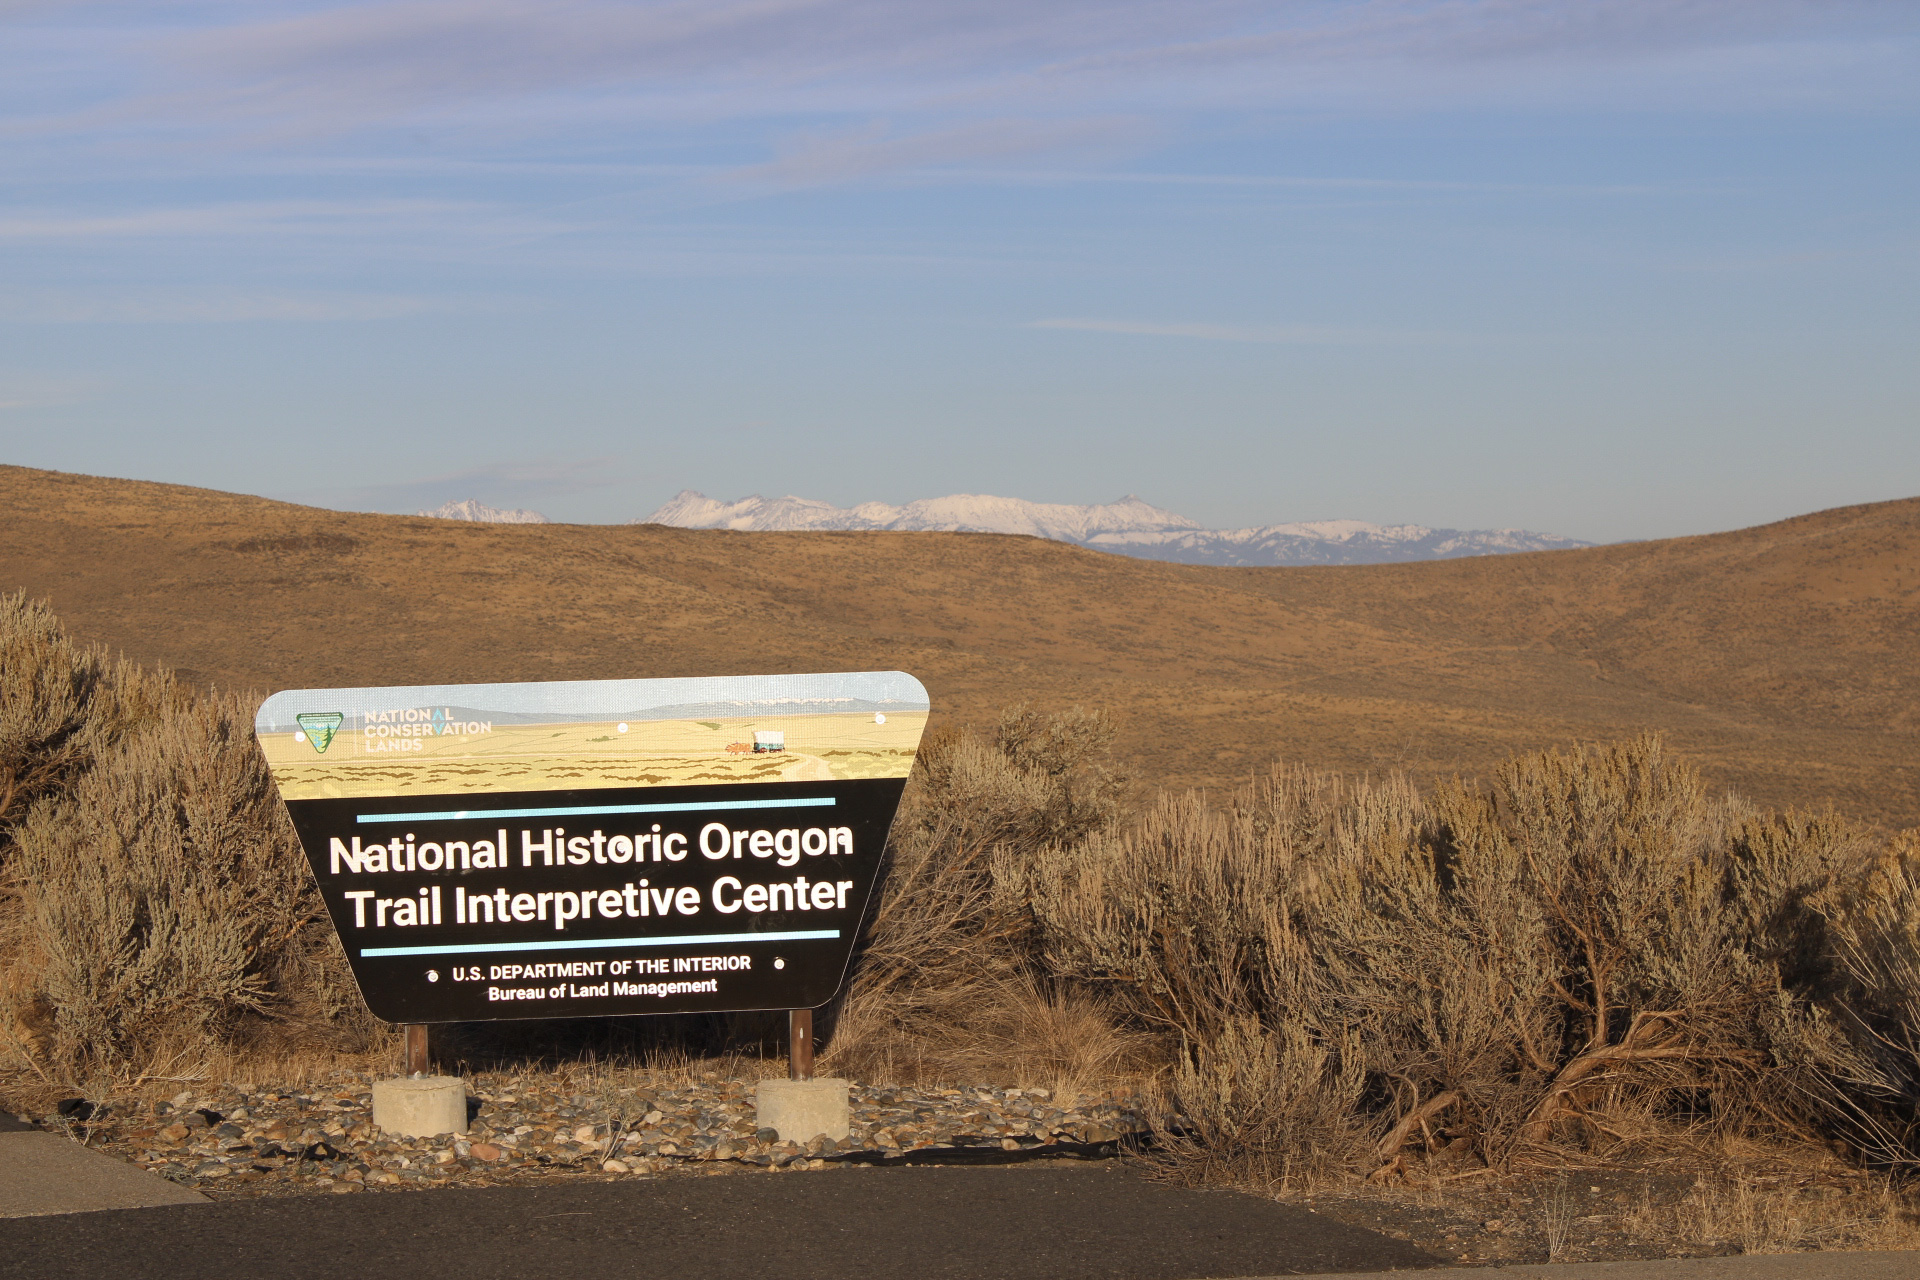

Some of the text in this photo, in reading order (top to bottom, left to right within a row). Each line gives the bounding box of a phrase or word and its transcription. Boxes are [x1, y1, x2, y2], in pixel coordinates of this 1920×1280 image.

[364, 707, 454, 723] NATIONAL
[364, 721, 492, 738] CONSERVATION
[365, 739, 423, 753] LANDS
[329, 822, 854, 875] National Historic Oregon
[344, 875, 854, 930] Trail Interpretive Center
[452, 955, 752, 982] U.S. DEPARTMENT OF THE INTERIOR
[488, 978, 718, 1002] Bureau of Land Management
